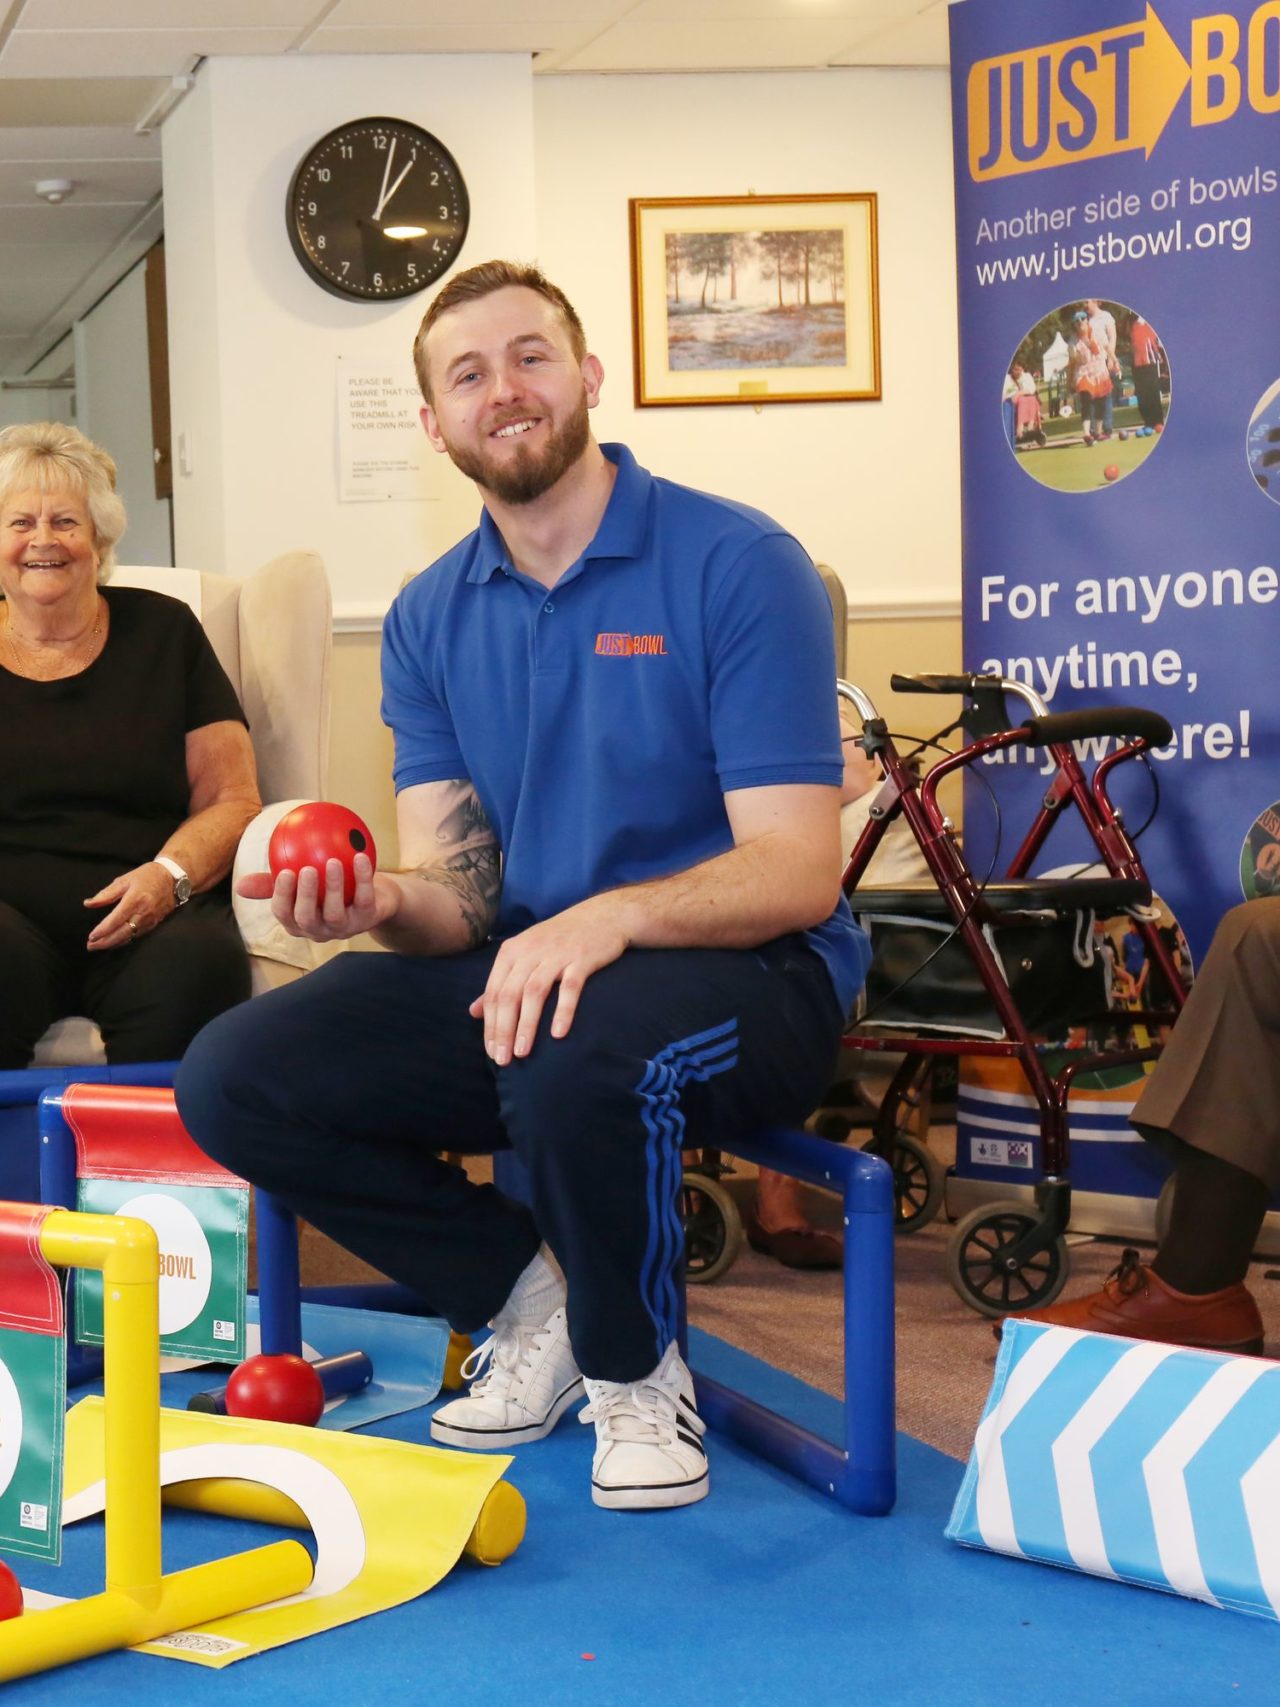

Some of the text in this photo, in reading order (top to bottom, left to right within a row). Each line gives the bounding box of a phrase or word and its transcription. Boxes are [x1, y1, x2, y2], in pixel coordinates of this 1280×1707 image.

[978, 31, 1145, 172] JUST
[373, 135, 387, 150] 12
[340, 146, 353, 160] 11
[410, 148, 417, 161] 1
[317, 168, 331, 182] 10
[430, 172, 439, 186] 2
[308, 202, 317, 216] 9
[976, 166, 1278, 245] Another side of bowls
[439, 206, 448, 220] 3
[318, 235, 326, 249] 8
[432, 239, 441, 252] 4
[976, 216, 1252, 286] www.justbowl.org
[341, 262, 350, 276] 7
[407, 263, 416, 277] 5
[373, 273, 382, 287] 6
[382, 388, 402, 396] THAT
[981, 566, 1279, 624] For anyone
[633, 635, 669, 655] BOWL
